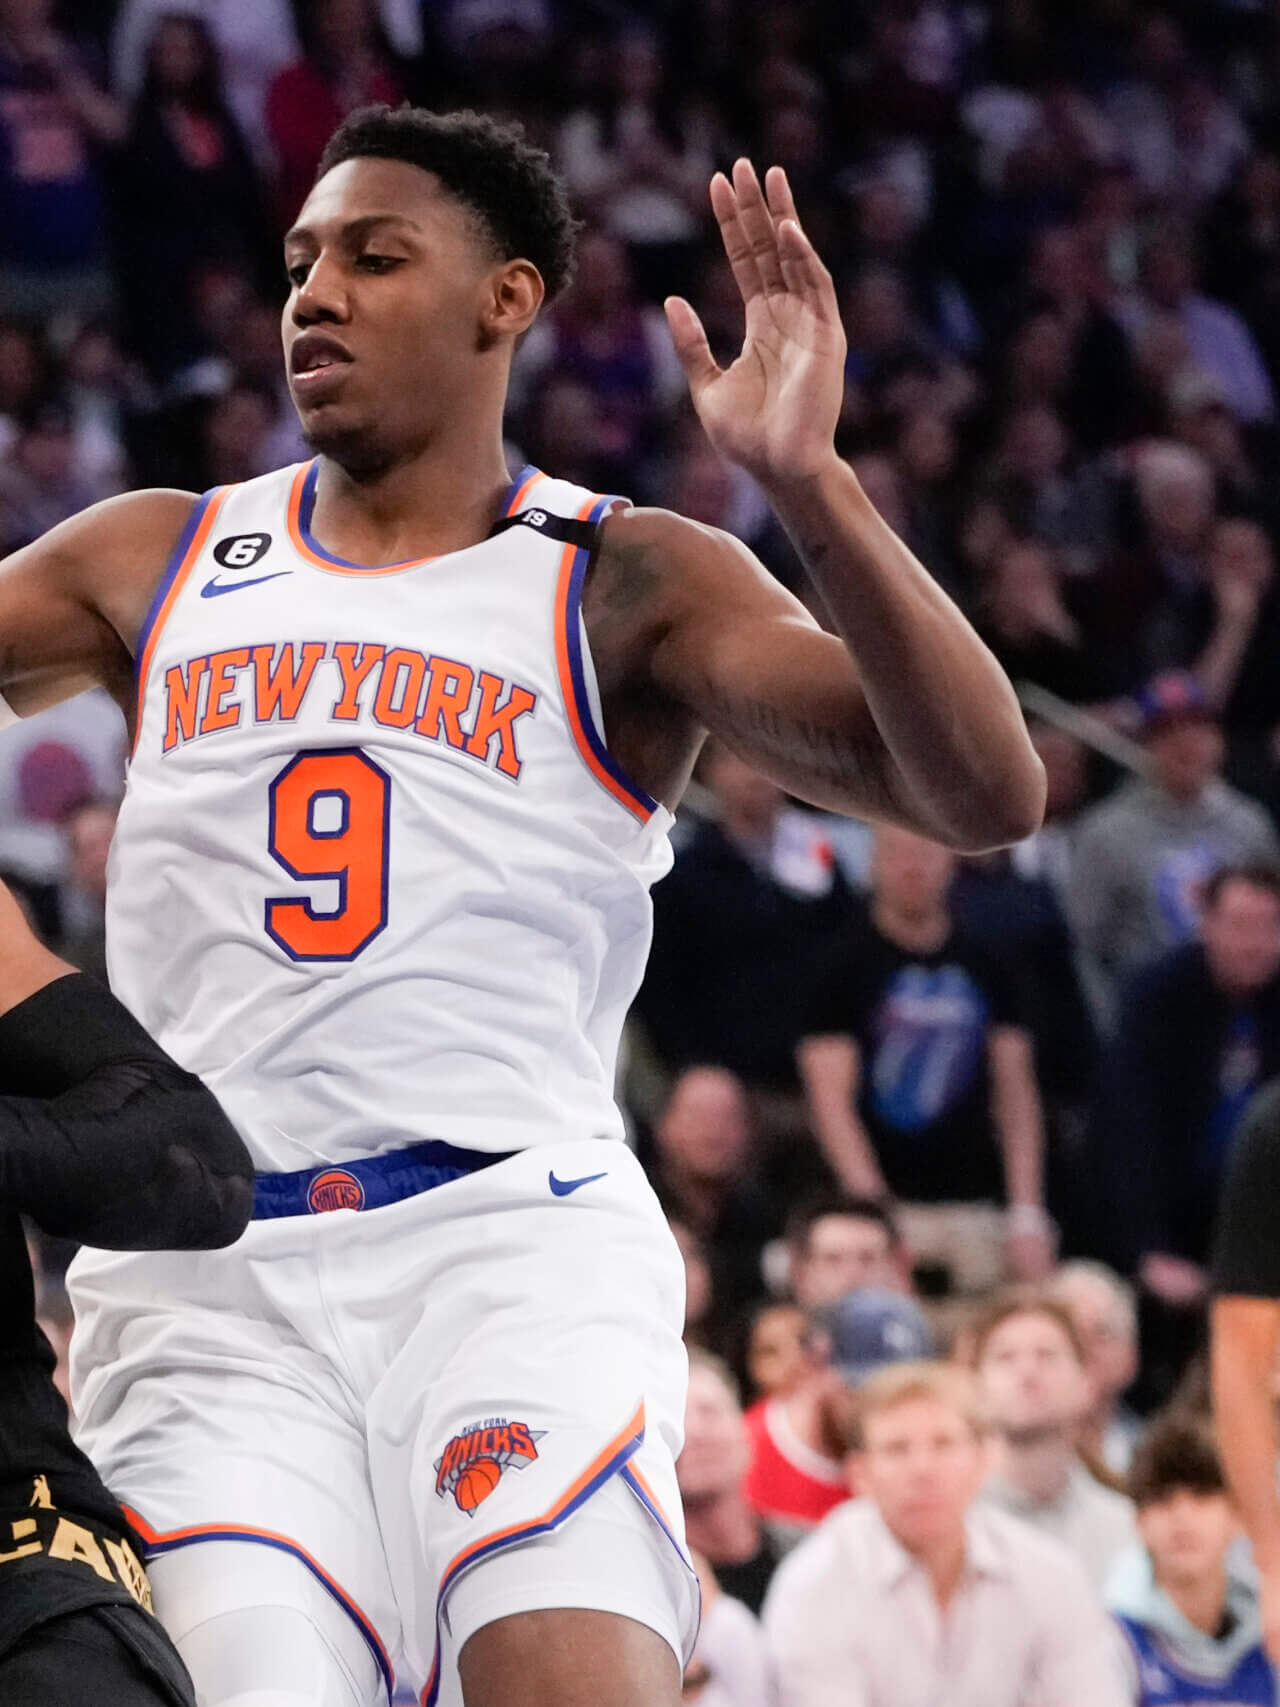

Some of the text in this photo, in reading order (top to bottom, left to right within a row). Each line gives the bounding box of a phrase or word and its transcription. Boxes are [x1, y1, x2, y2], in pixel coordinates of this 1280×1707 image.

[223, 537, 263, 566] 6
[522, 509, 548, 527] 19
[162, 641, 536, 780] NEW YORK
[264, 746, 392, 962] 9
[436, 1421, 539, 1494] KNICKS
